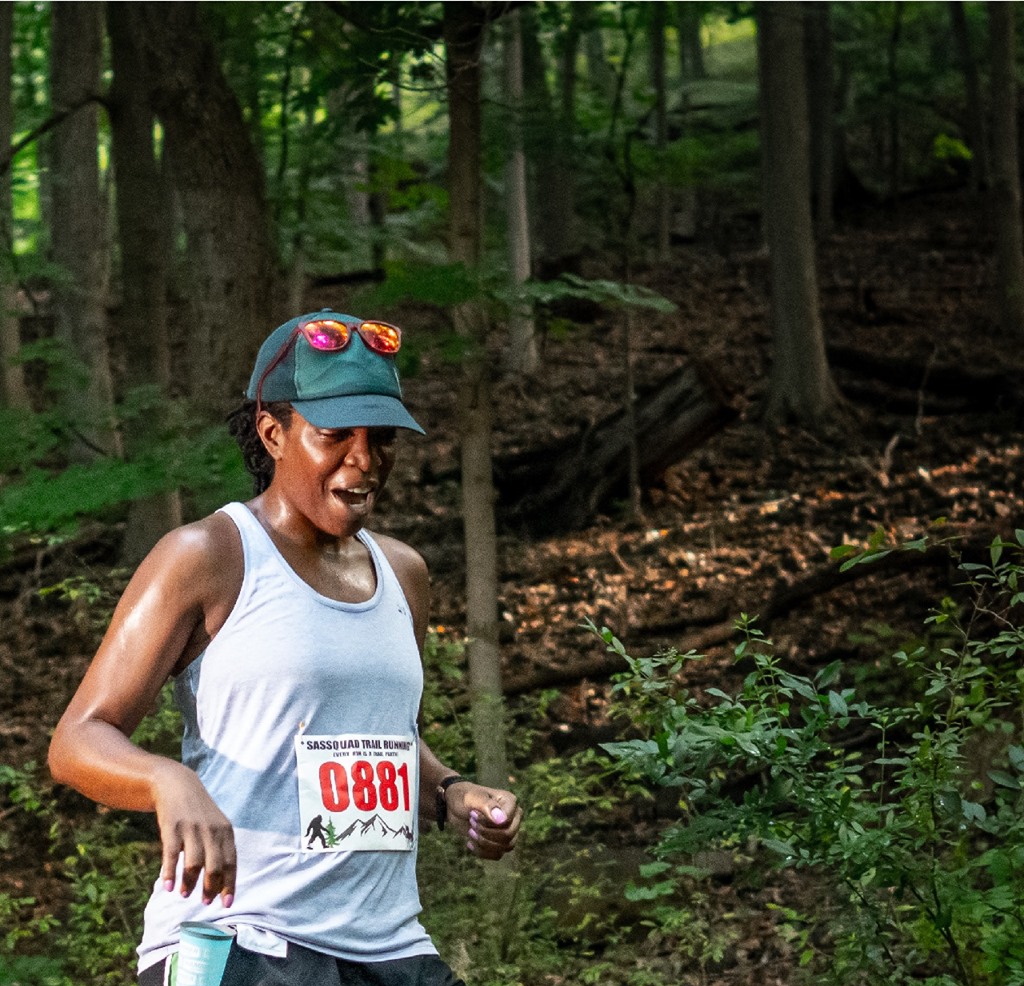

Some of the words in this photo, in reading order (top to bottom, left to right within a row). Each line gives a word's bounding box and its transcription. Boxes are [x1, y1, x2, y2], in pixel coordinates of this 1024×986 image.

[306, 739, 360, 751] SASSQUAD
[361, 739, 382, 749] TRAIL
[319, 760, 410, 812] 0881
